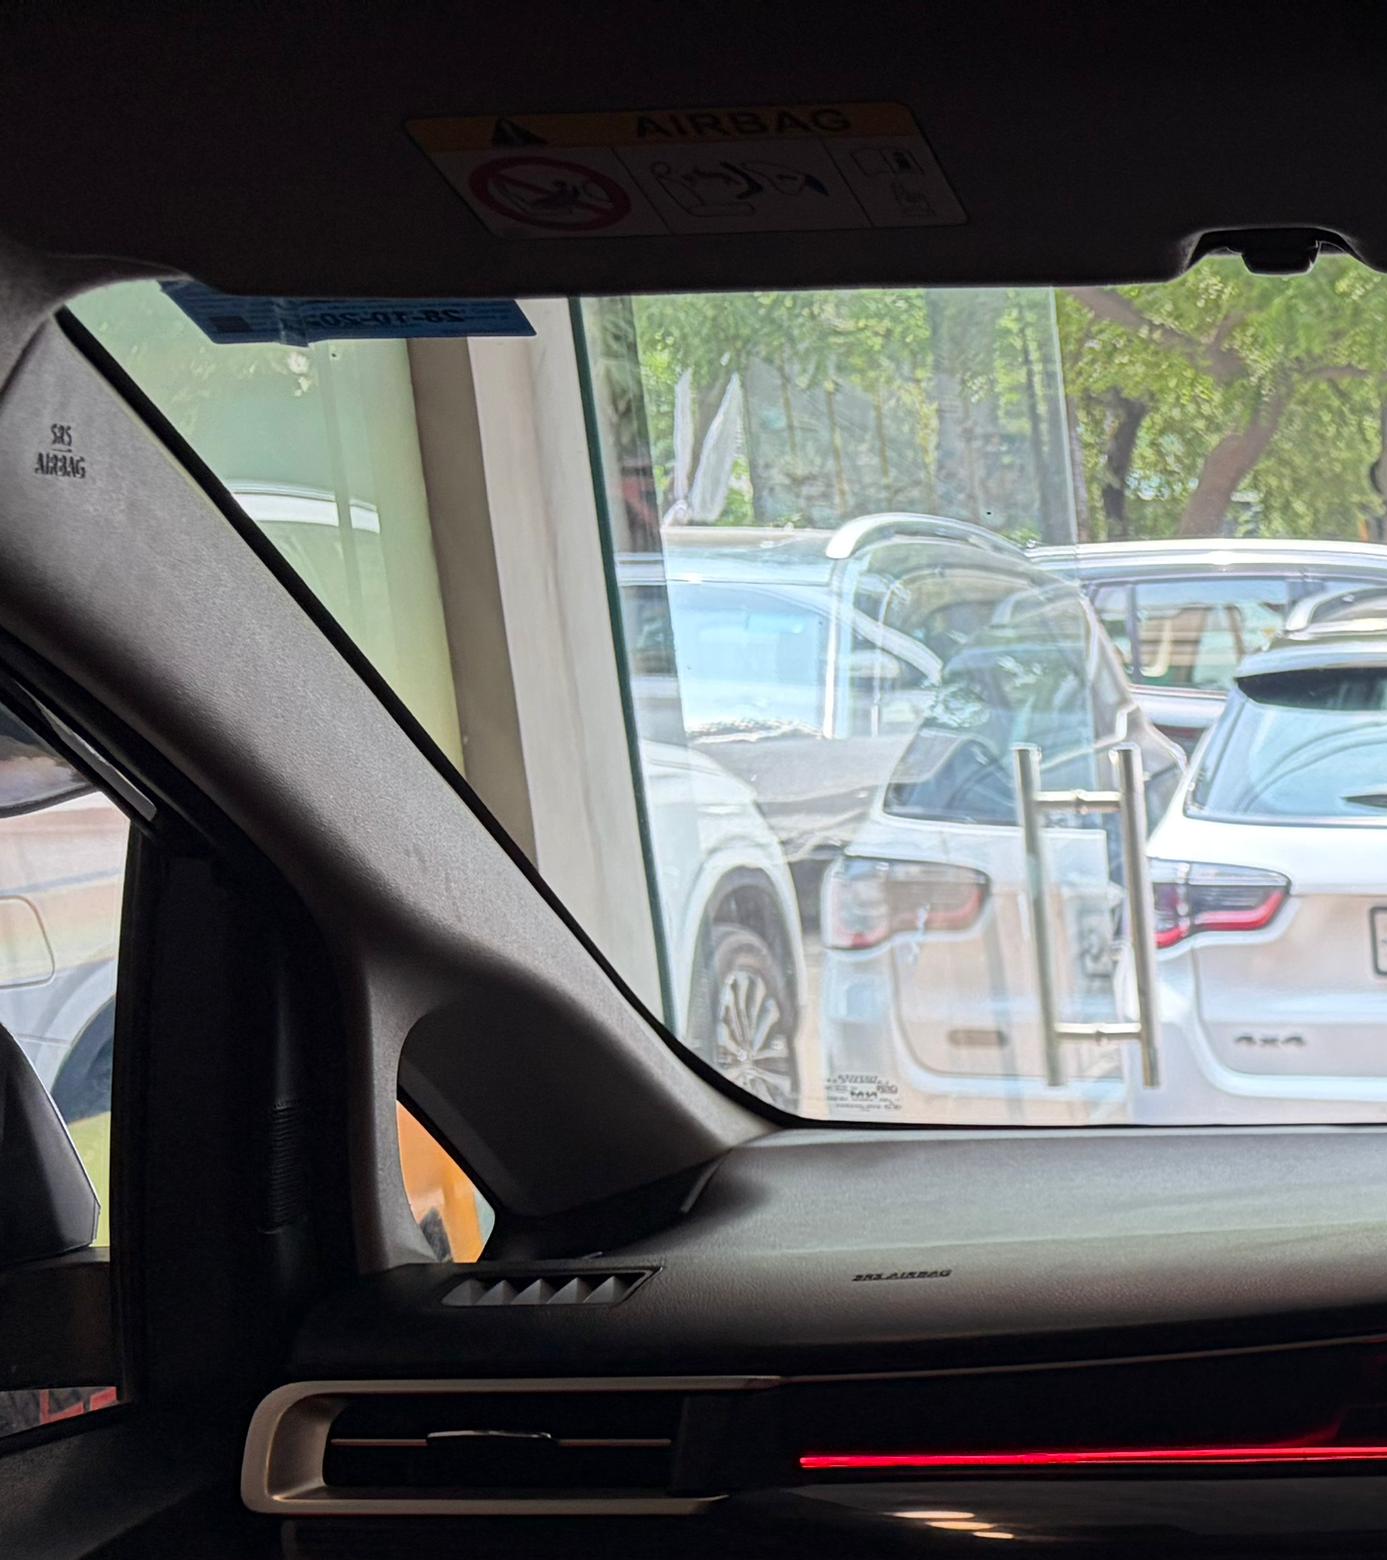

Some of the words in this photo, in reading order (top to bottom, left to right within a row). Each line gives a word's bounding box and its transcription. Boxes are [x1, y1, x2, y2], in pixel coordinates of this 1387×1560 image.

[637, 109, 850, 137] AIRBAG
[51, 424, 72, 446] SRS
[35, 452, 85, 478] AIRBAG
